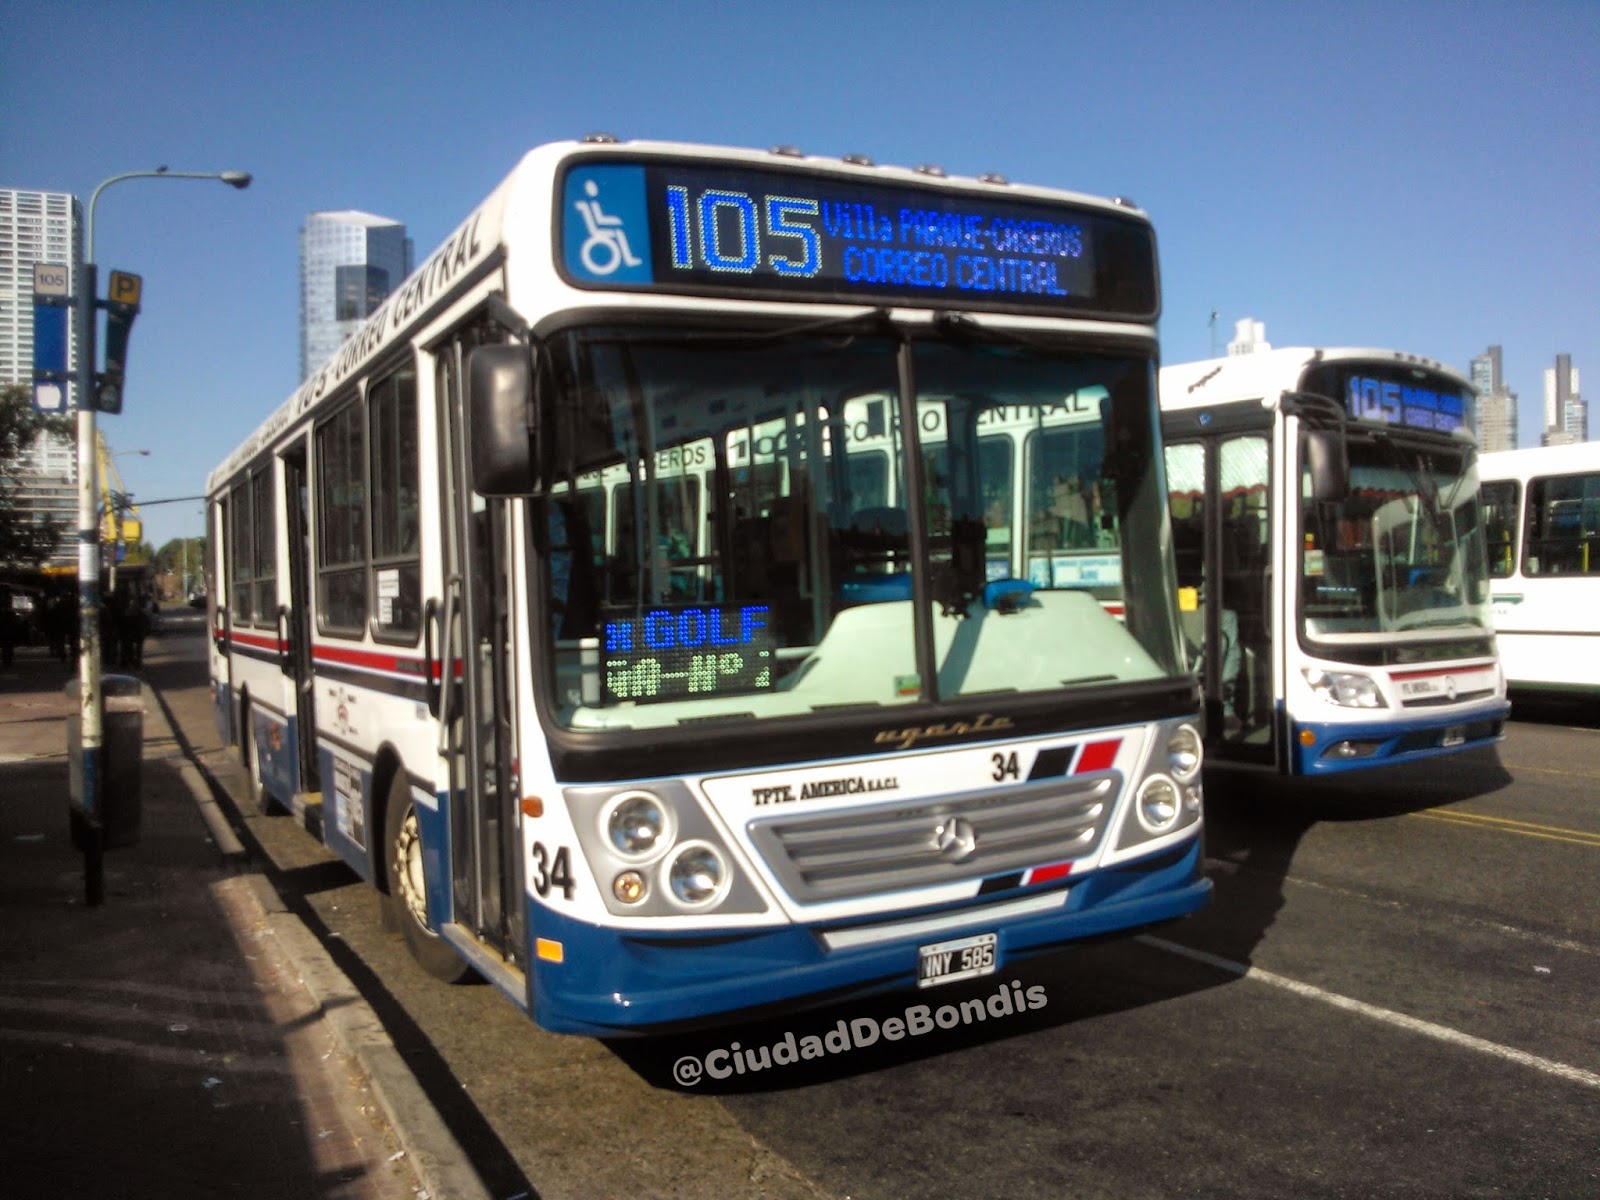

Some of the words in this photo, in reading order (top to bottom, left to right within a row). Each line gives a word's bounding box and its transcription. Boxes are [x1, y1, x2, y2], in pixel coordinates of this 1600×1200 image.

[666, 185, 820, 278] 105
[38, 273, 65, 287] 105
[116, 276, 135, 299] P
[393, 211, 483, 328] CENTRAL
[843, 246, 949, 289] CORREO
[955, 254, 1069, 297] CENTRAL
[1349, 375, 1402, 423] 105
[644, 606, 769, 648] GOLF
[800, 777, 866, 800] AMERICA
[991, 751, 1019, 783] 34
[532, 840, 577, 901] 34
